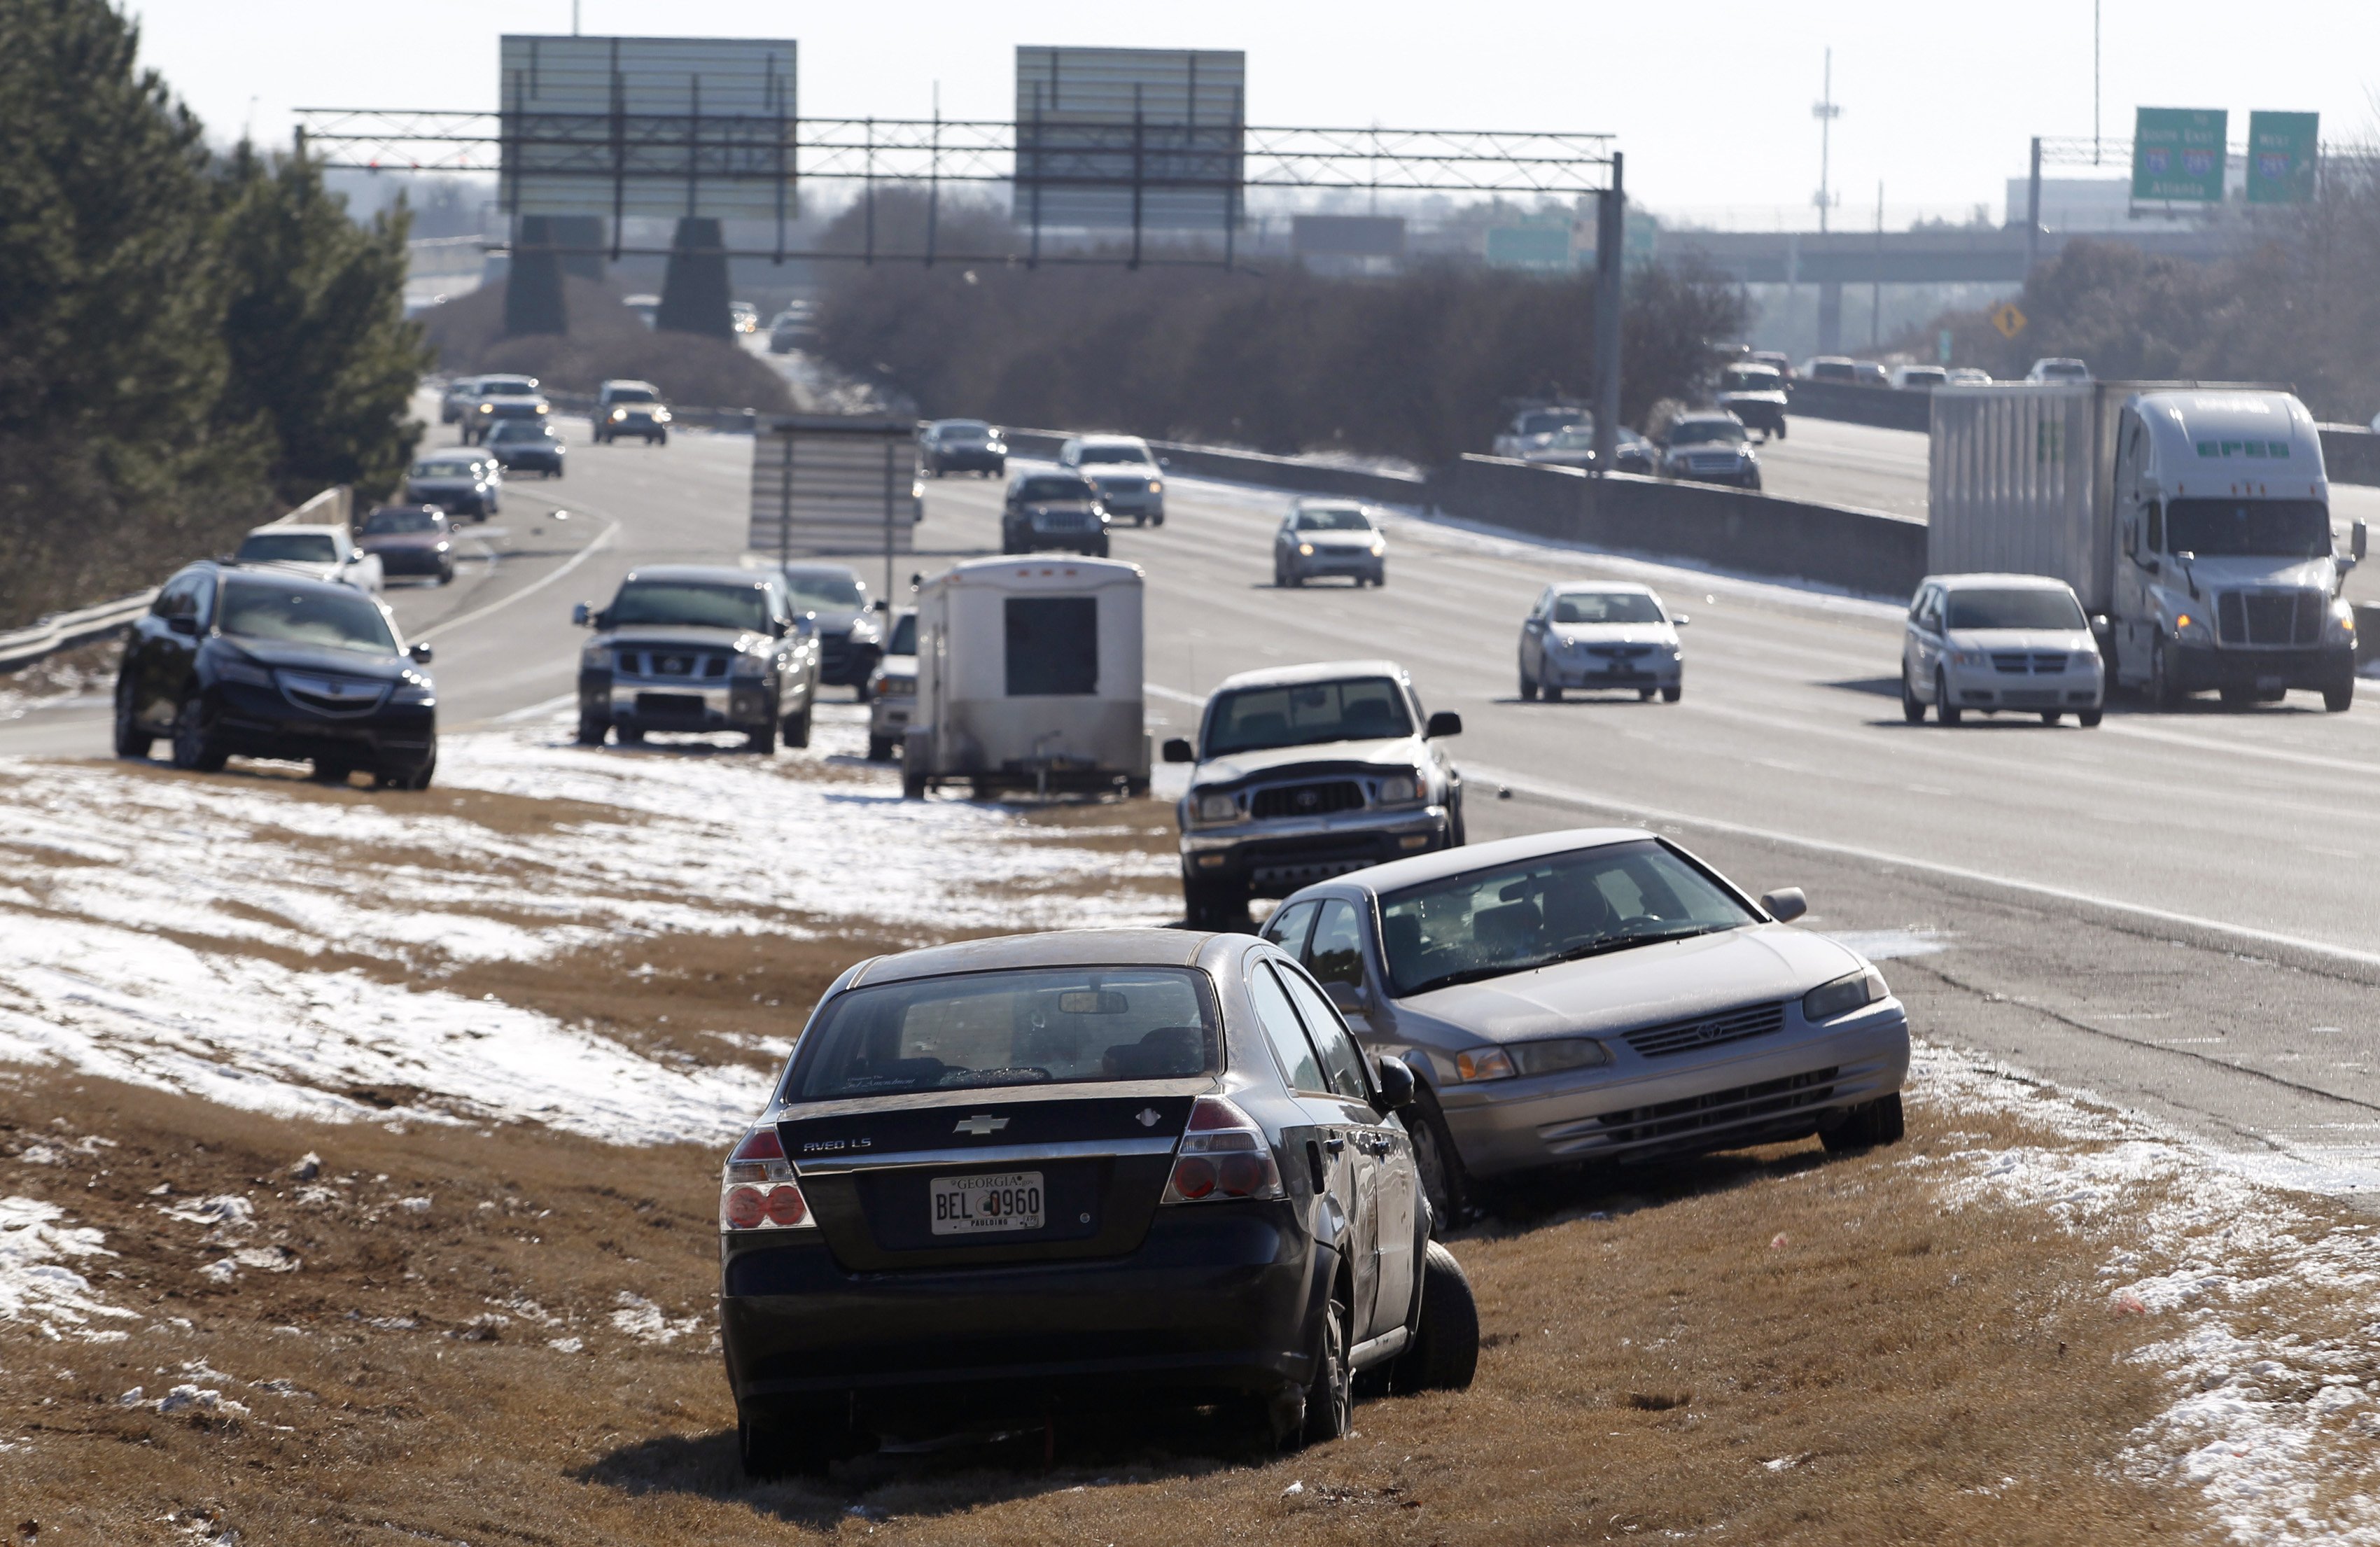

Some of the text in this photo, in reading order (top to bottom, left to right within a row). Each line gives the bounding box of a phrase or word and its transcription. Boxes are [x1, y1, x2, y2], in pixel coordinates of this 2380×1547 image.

[804, 1138, 872, 1152] AVEO LS
[990, 1187, 1040, 1217] 0960
[971, 1217, 1008, 1226] PAULDING
